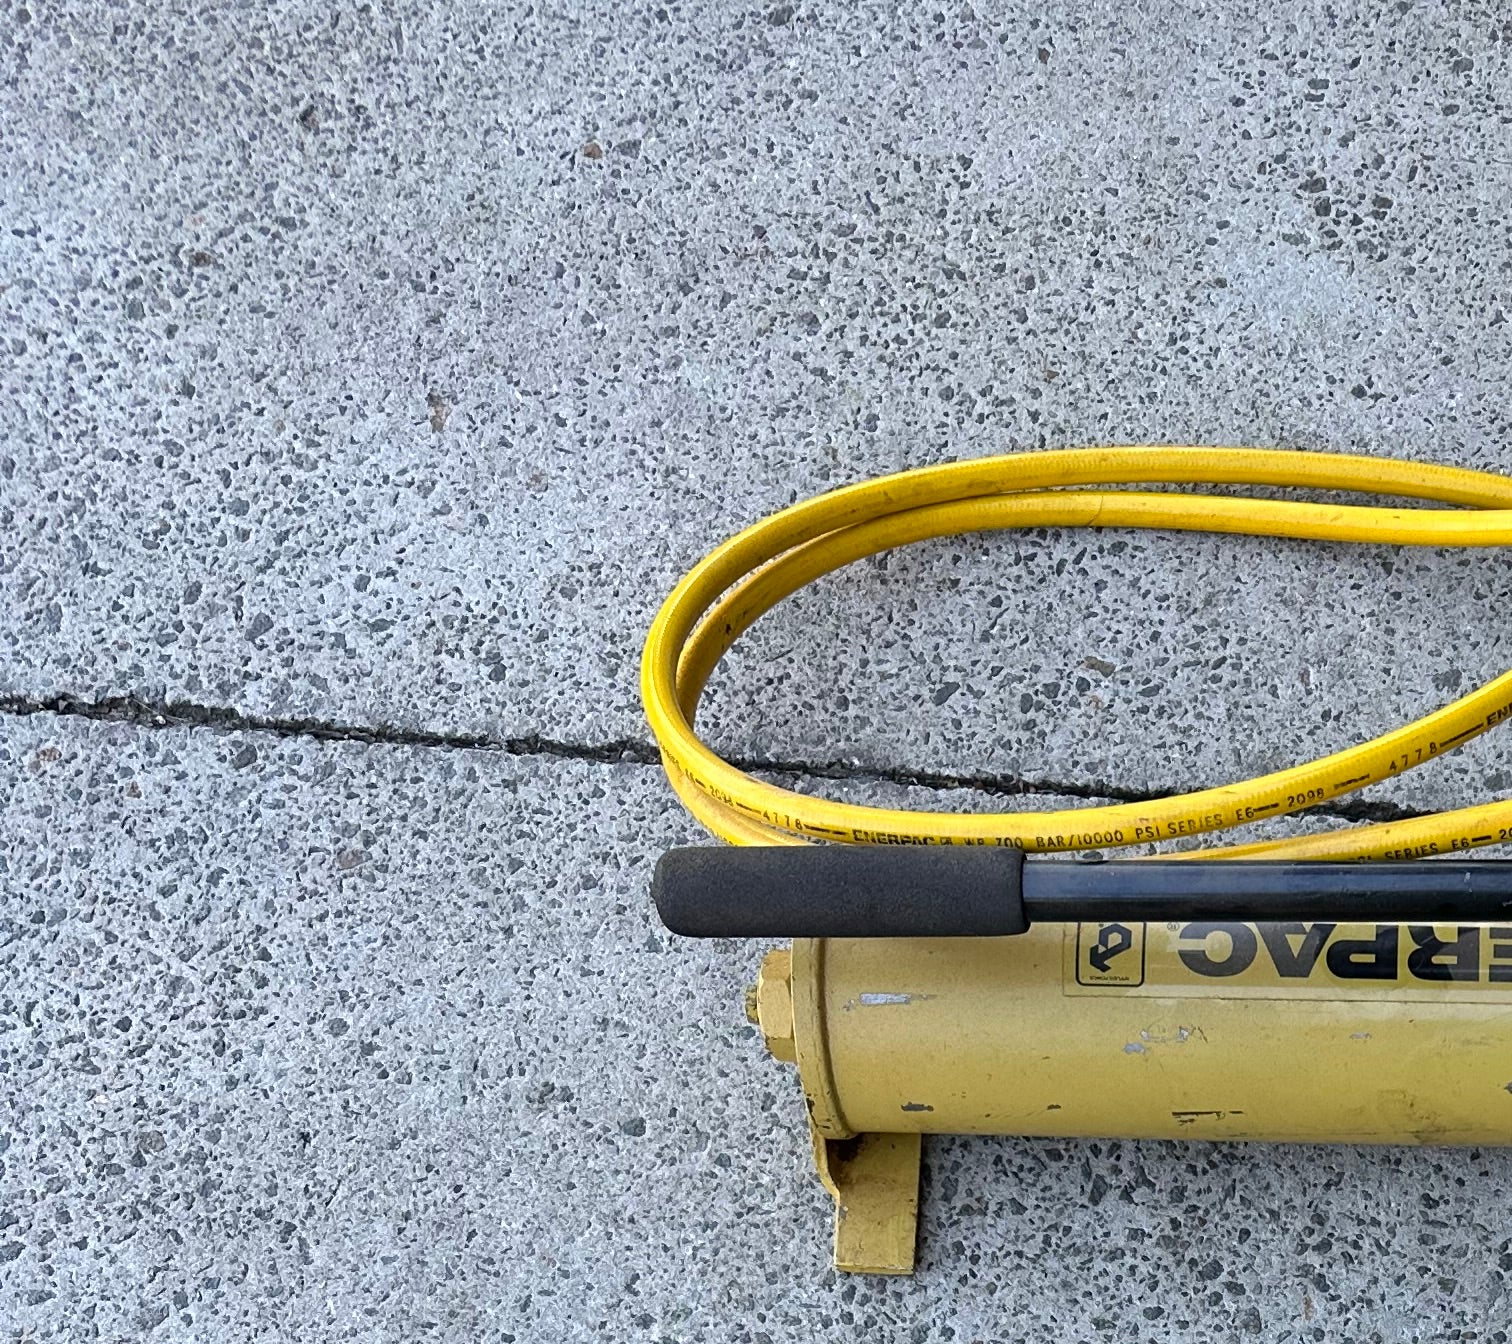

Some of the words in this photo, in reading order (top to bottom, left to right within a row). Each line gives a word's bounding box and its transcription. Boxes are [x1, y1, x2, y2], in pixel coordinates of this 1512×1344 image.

[1036, 829, 1124, 850] BAR/10000
[1135, 826, 1161, 840] PSI
[1168, 813, 1224, 835] SERIES
[1236, 807, 1255, 821] E6
[1287, 787, 1325, 808] 2098
